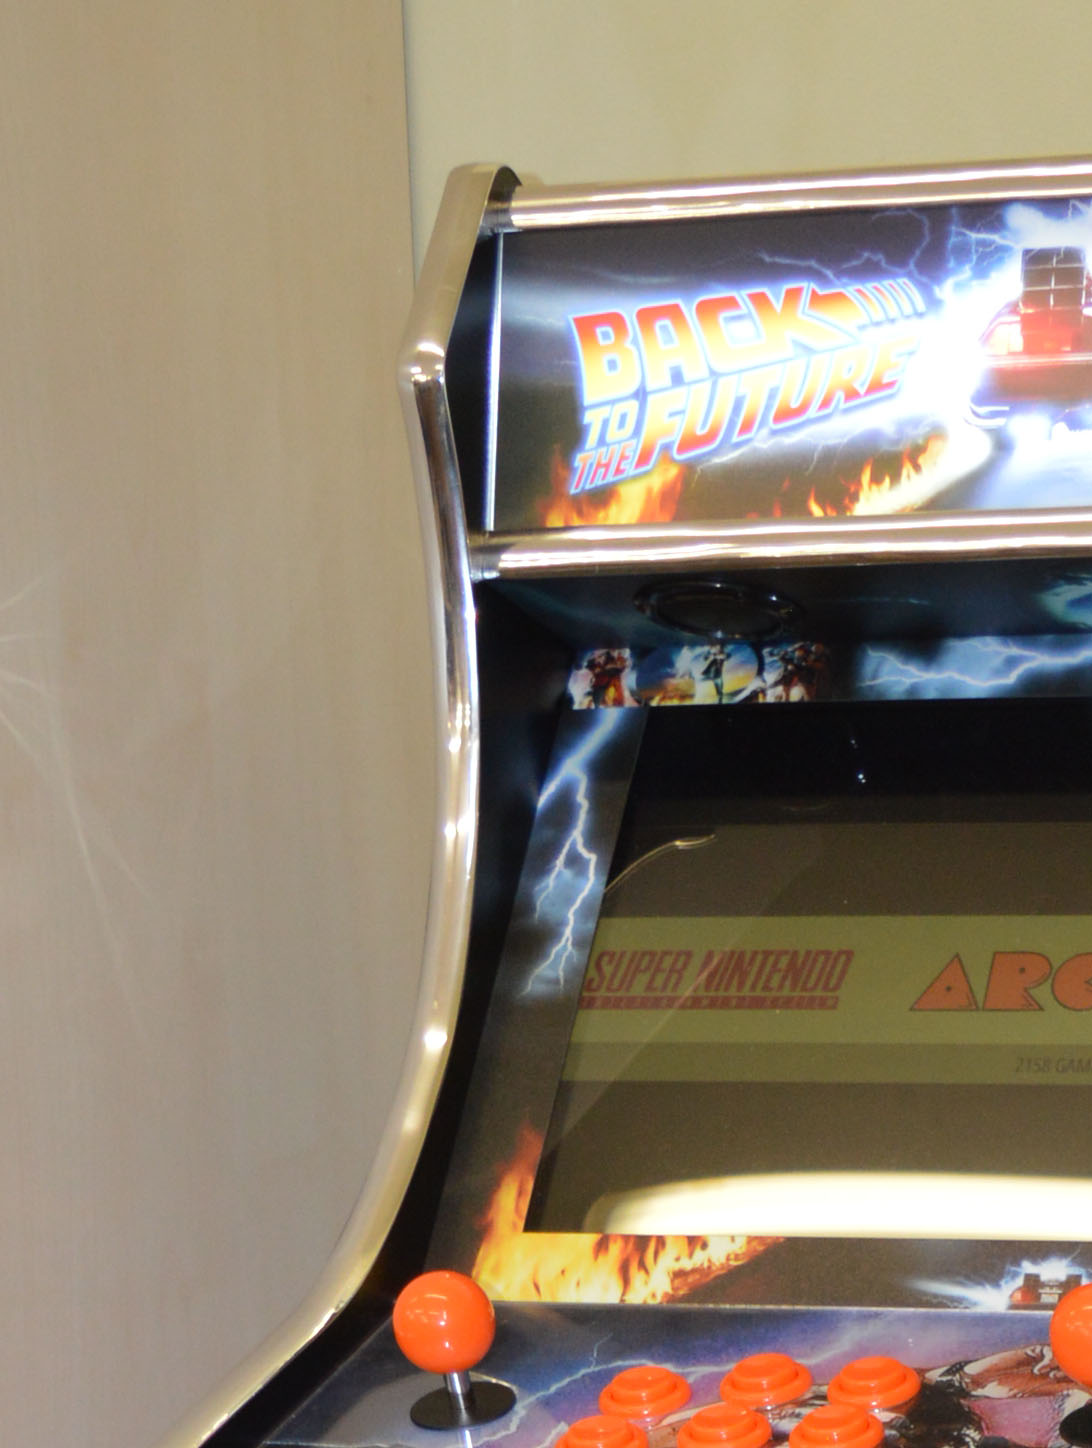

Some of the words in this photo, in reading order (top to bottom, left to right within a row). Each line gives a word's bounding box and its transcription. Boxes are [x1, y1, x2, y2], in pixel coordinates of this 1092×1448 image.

[568, 280, 862, 407] BACK
[570, 439, 638, 494] THE
[628, 338, 920, 474] FUTURE
[583, 399, 640, 450] TO
[583, 949, 694, 993] SUPER
[694, 949, 854, 993] NINTENDO
